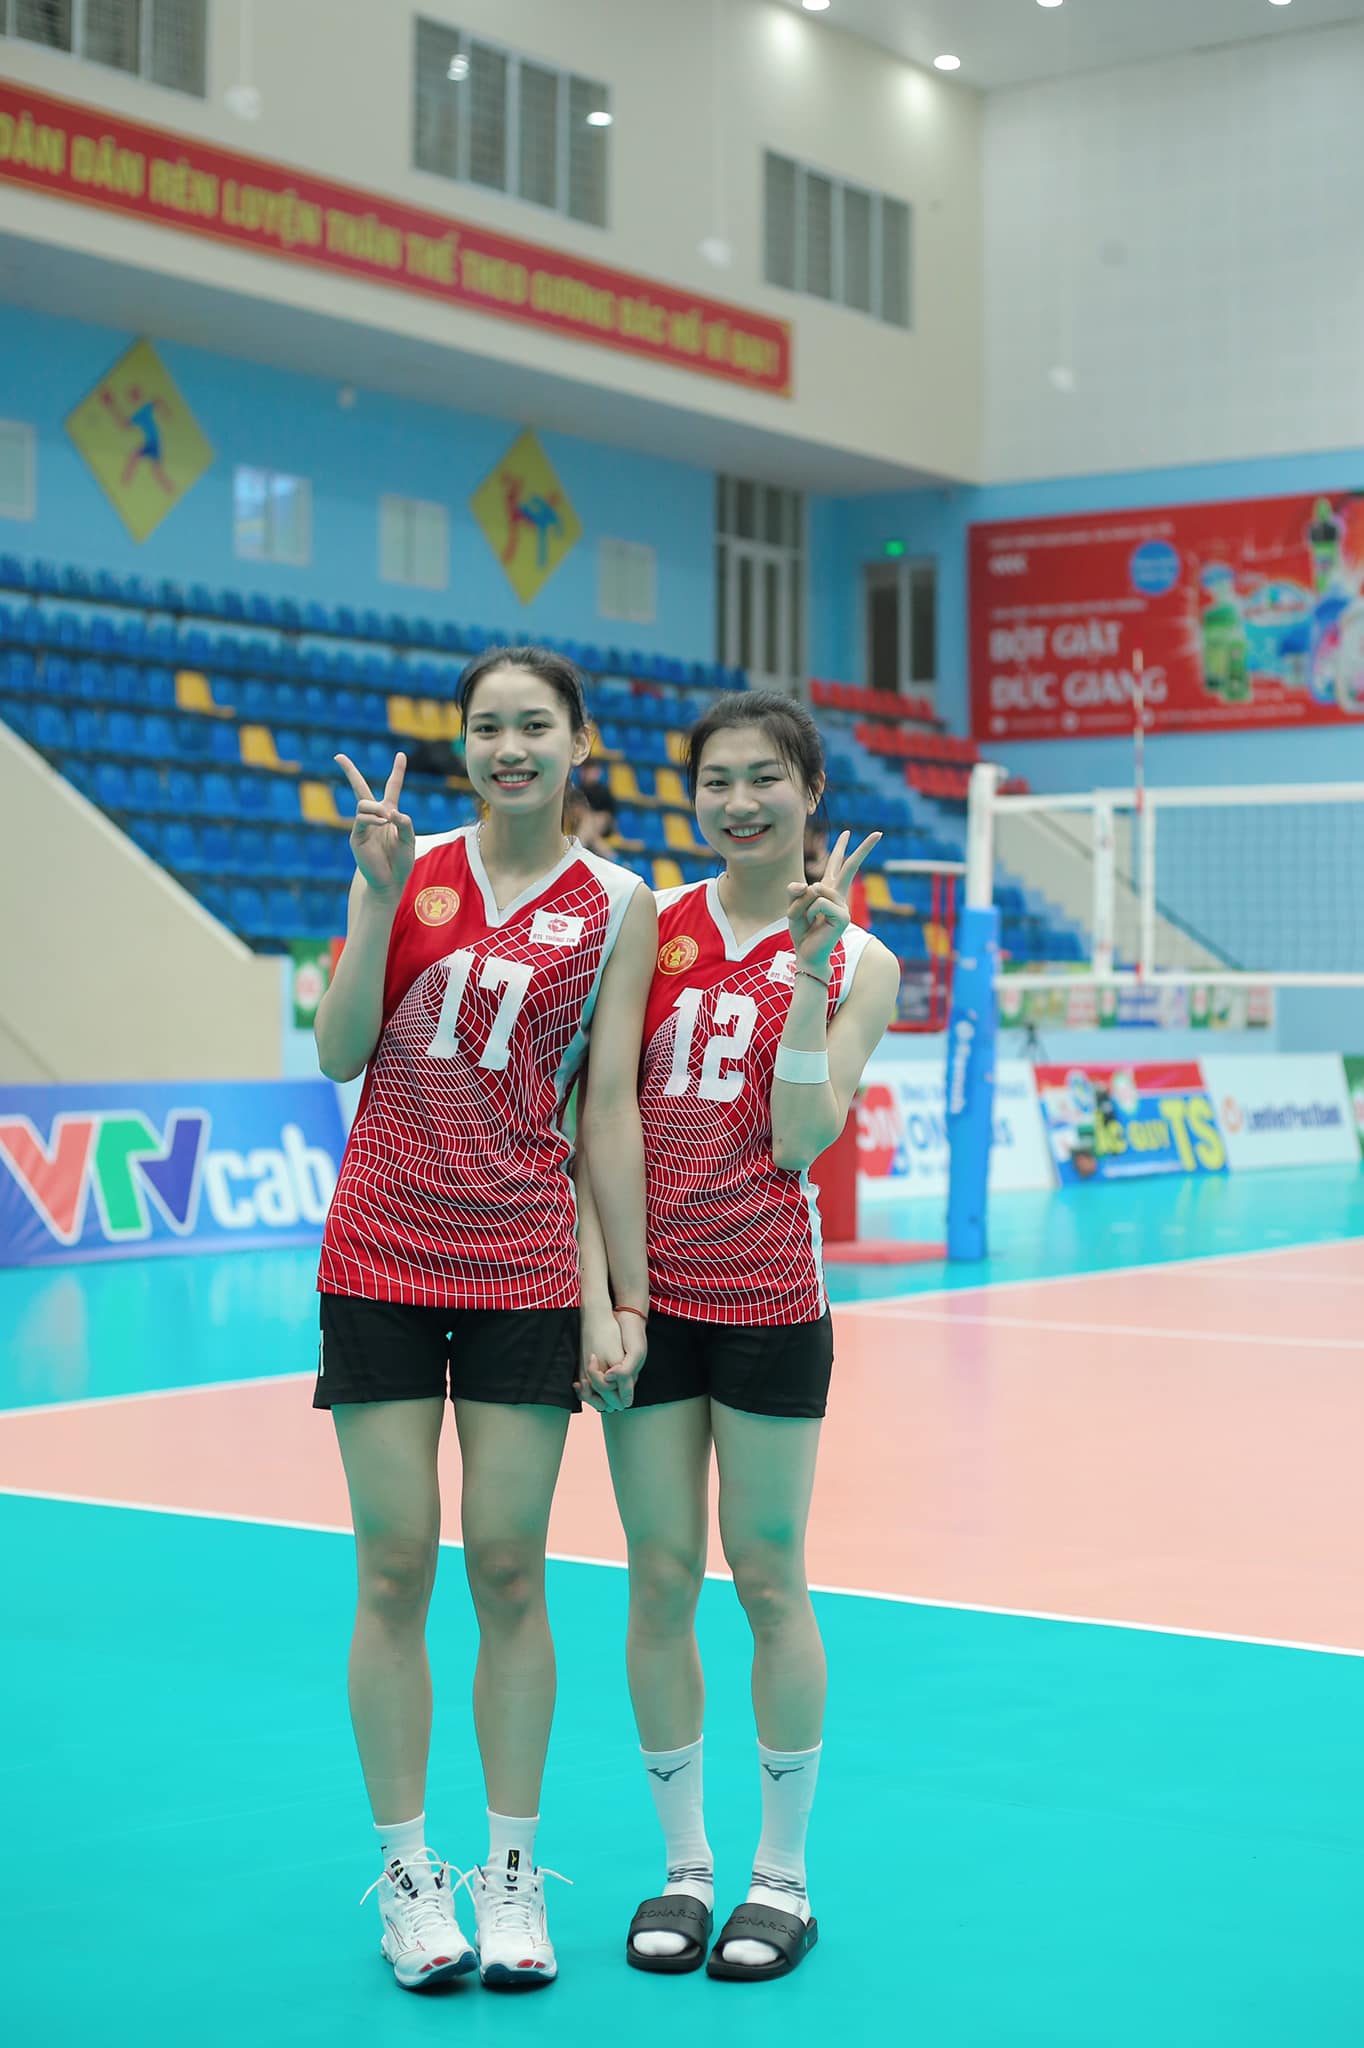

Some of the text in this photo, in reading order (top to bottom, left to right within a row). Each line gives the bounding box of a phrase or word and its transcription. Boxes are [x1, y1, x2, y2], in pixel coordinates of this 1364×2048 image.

[425, 948, 535, 1071] 17
[662, 986, 759, 1103] 12
[1157, 1095, 1226, 1172] TS
